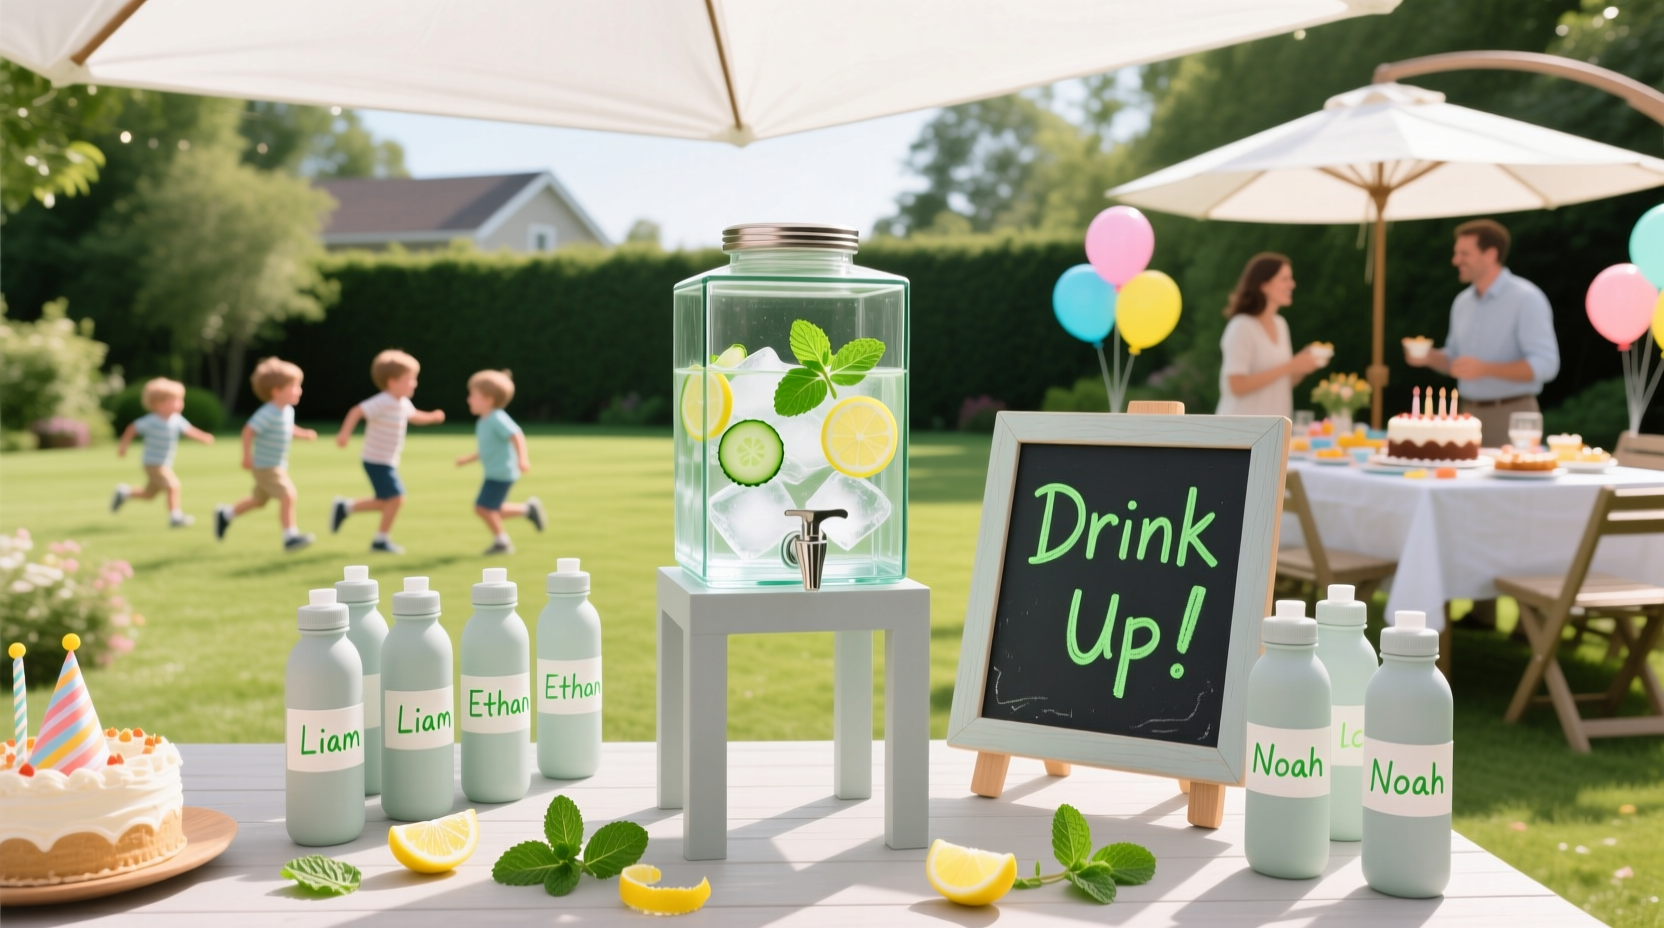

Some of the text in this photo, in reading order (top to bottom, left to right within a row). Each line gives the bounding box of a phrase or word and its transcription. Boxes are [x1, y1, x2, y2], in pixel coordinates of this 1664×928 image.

[1028, 482, 1219, 568] Drink
[1066, 584, 1207, 699] Up!
[545, 673, 601, 700] Ethan
[398, 704, 451, 734] Liam
[469, 689, 529, 718] Ethan
[301, 725, 360, 755] Liam
[1253, 742, 1323, 778] Noah
[1370, 758, 1444, 796] Noah
